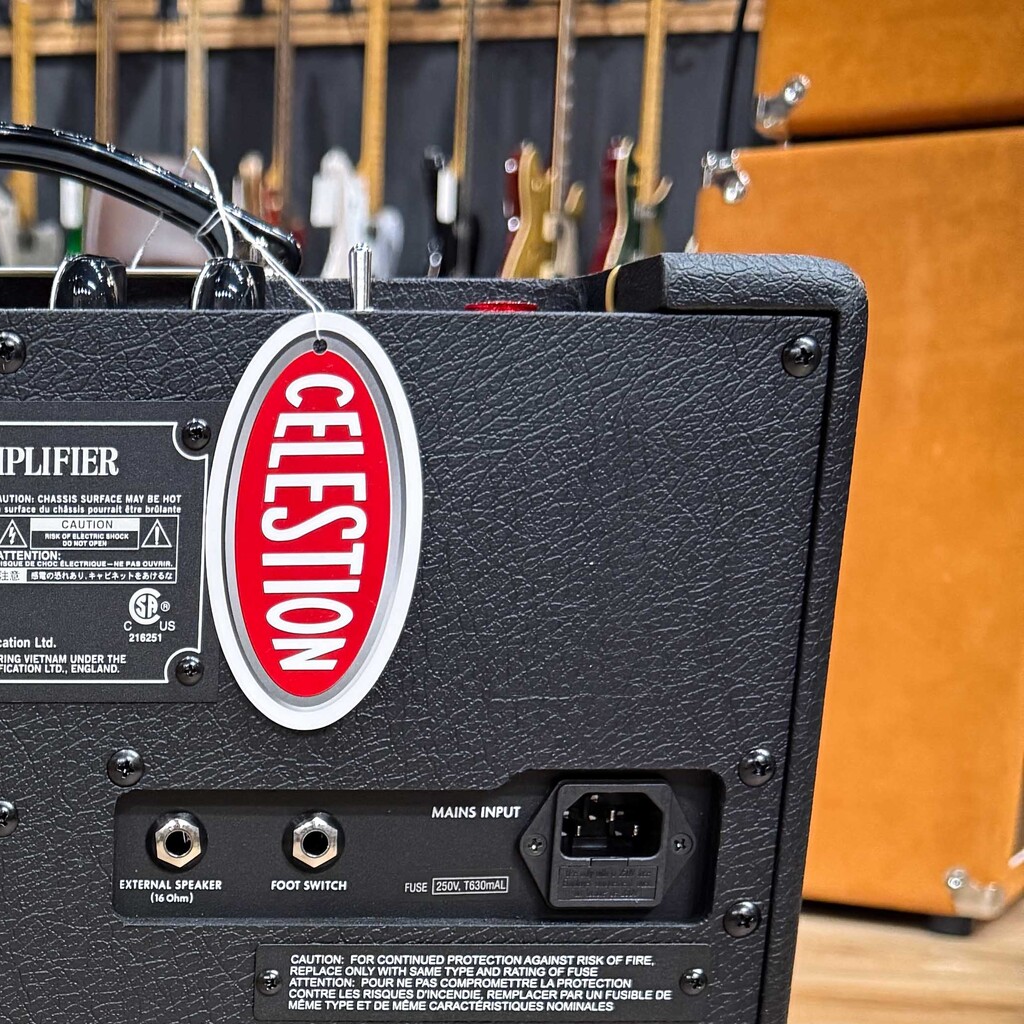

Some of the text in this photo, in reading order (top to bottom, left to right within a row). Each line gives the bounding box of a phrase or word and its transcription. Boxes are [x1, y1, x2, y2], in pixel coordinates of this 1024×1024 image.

[38, 494, 78, 504] CHASSIS
[80, 494, 122, 504] SURFACE
[126, 494, 144, 504] MAY
[148, 494, 160, 504] BE
[162, 494, 182, 504] HOT
[4, 505, 36, 514] surface
[39, 505, 50, 514] du
[53, 505, 84, 514] châssis
[88, 505, 122, 515] pourrait
[125, 505, 142, 514] être
[145, 505, 182, 514] brûlante
[61, 520, 113, 529] CAUTION
[260, 373, 367, 671] CELESTION
[124, 620, 176, 631] C US
[35, 636, 56, 648] Ltd.
[128, 633, 162, 642] 216251
[24, 654, 66, 663] VIETNAM
[70, 654, 104, 663] UNDER
[107, 654, 126, 664] THE
[44, 664, 68, 674] LTD.,
[70, 664, 120, 673] ENGLAND.
[431, 806, 522, 818] MAINS INPUT
[119, 880, 222, 890] EXTERNAL SPEAKER
[270, 880, 348, 891] FOOT SWITCH
[404, 882, 428, 892] FUSE
[464, 880, 506, 890] T630mAL
[150, 893, 194, 904] (16 Ohm)
[290, 955, 654, 966] CAUTION: FOR CONTINUED PROTECTION AGAINST RISK OF FIRE,
[290, 966, 598, 976] REPLACE ONLY WITH SAME TYPE AND RATING OF FUSE
[289, 978, 632, 988] ATTENTION: POUR NE PAS COMPROMETTRE LA PROTECTION
[288, 989, 673, 1000] CONTRE LES RISQUES D'INCENDIE, REMPLACER PAR UN FUSIBLE DE
[288, 999, 614, 1011] MÊME TYPE ET DE MÊME CARACTÉRISTIQUES NOMINALES
